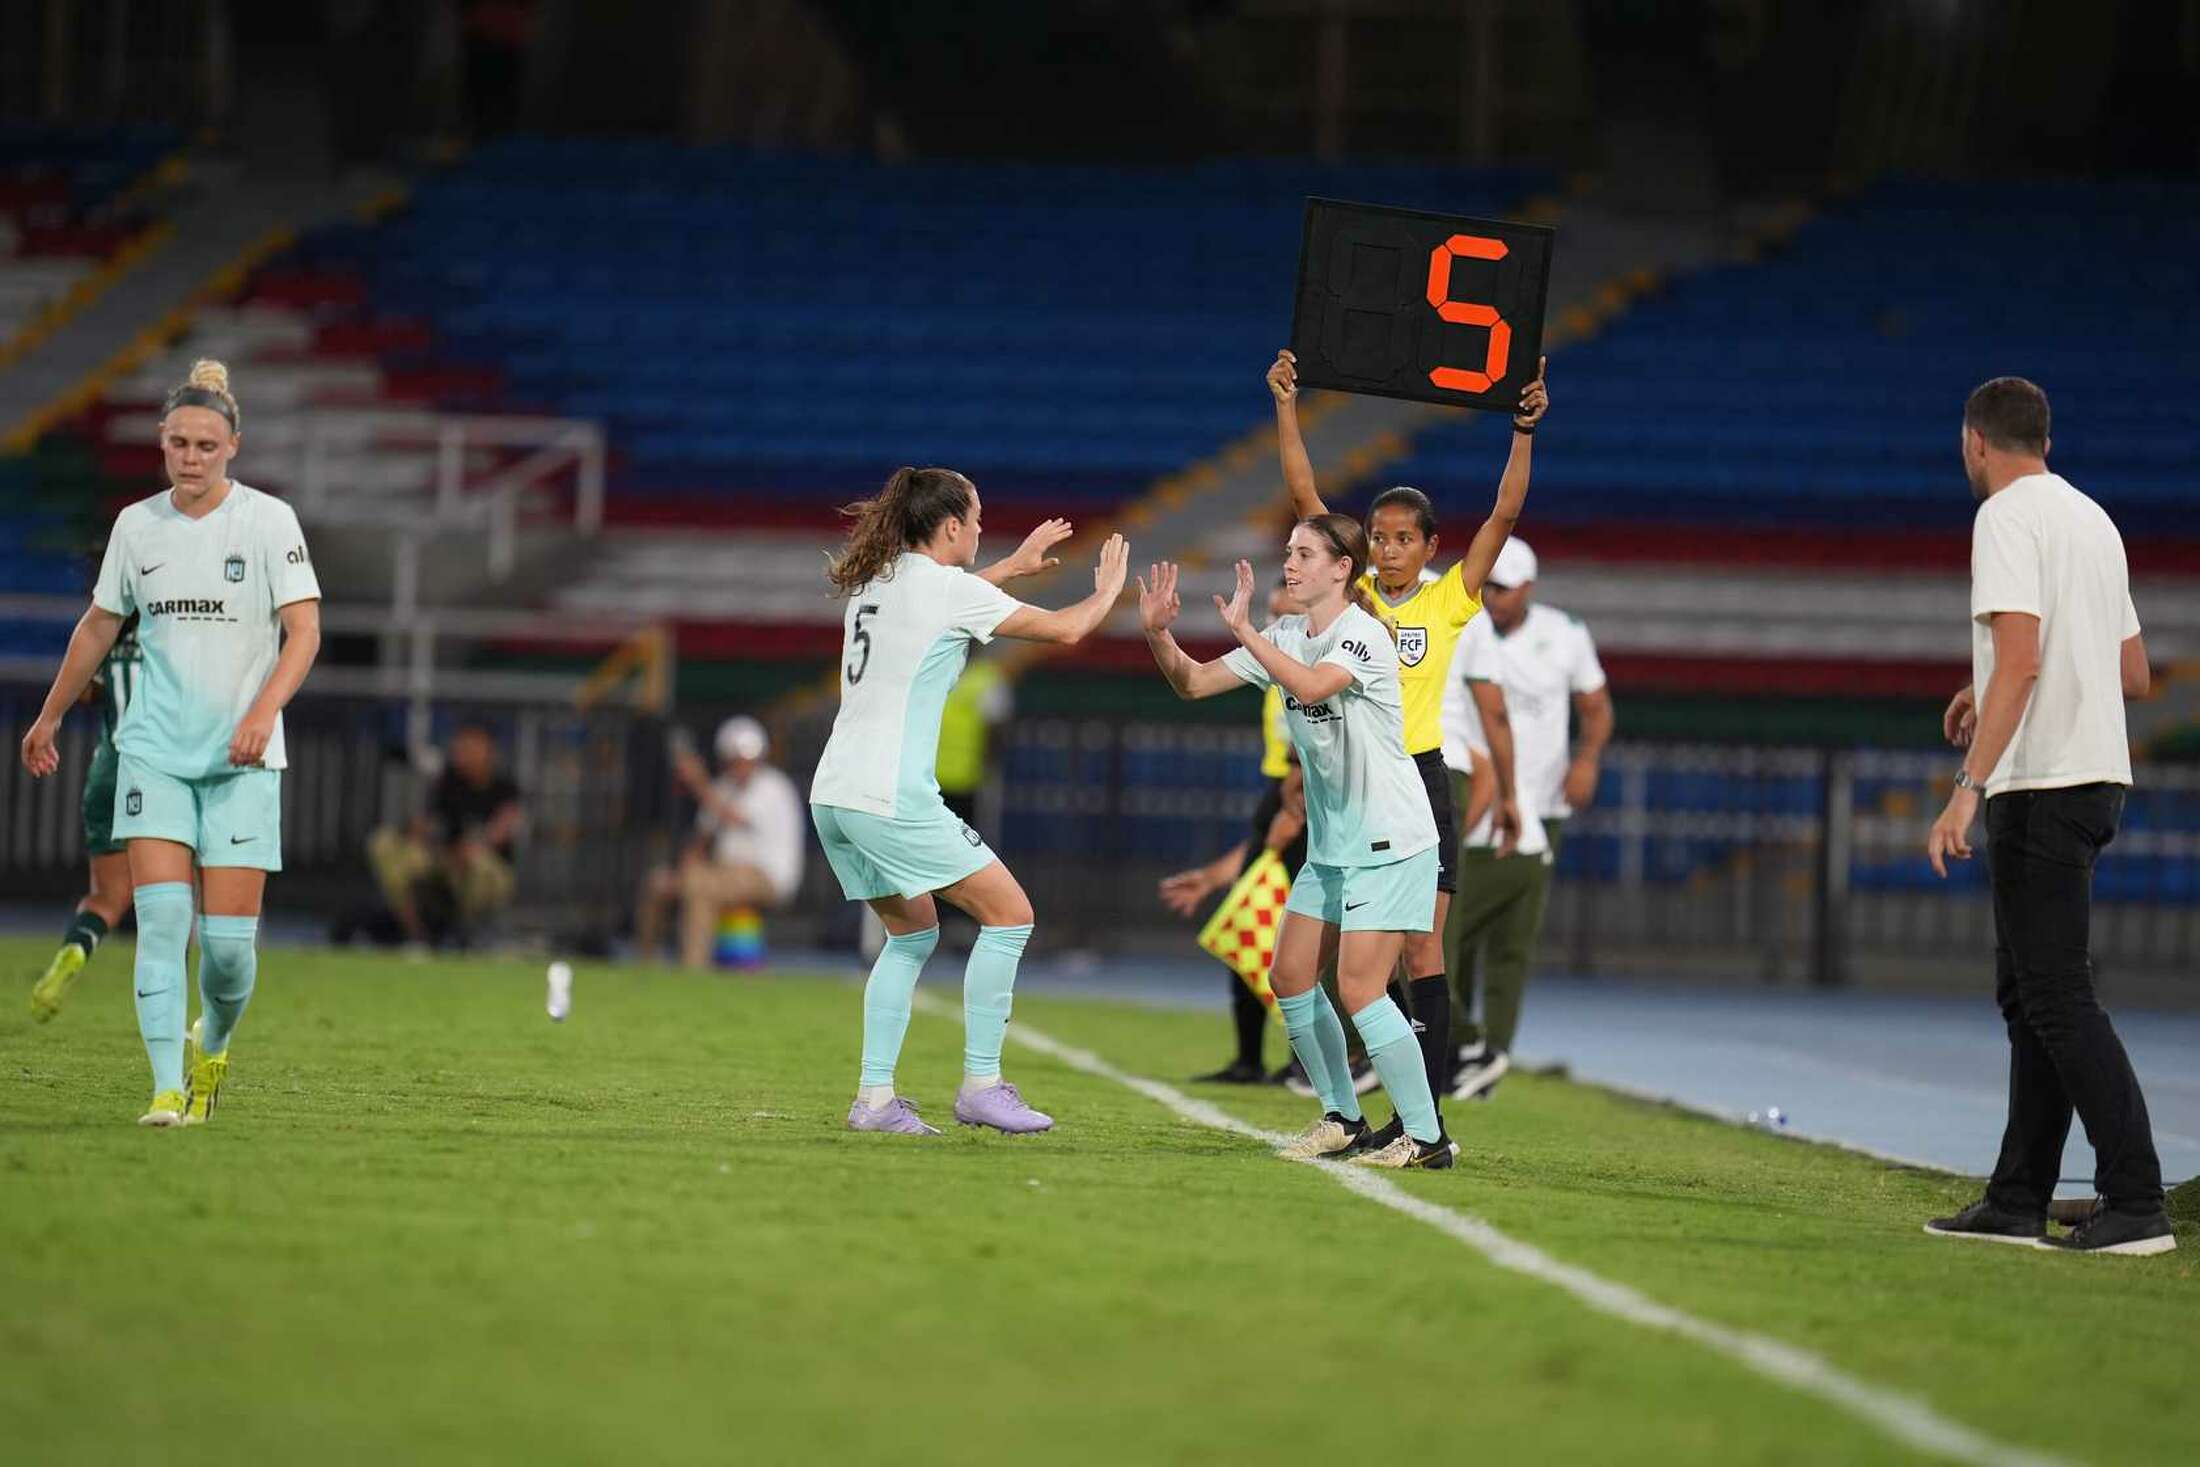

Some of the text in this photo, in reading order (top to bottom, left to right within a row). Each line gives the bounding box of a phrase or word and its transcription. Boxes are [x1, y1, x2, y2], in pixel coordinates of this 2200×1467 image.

[1426, 234, 1511, 393] 5
[847, 605, 879, 686] 5
[1341, 640, 1371, 662] ally
[1400, 638, 1422, 652] FCF
